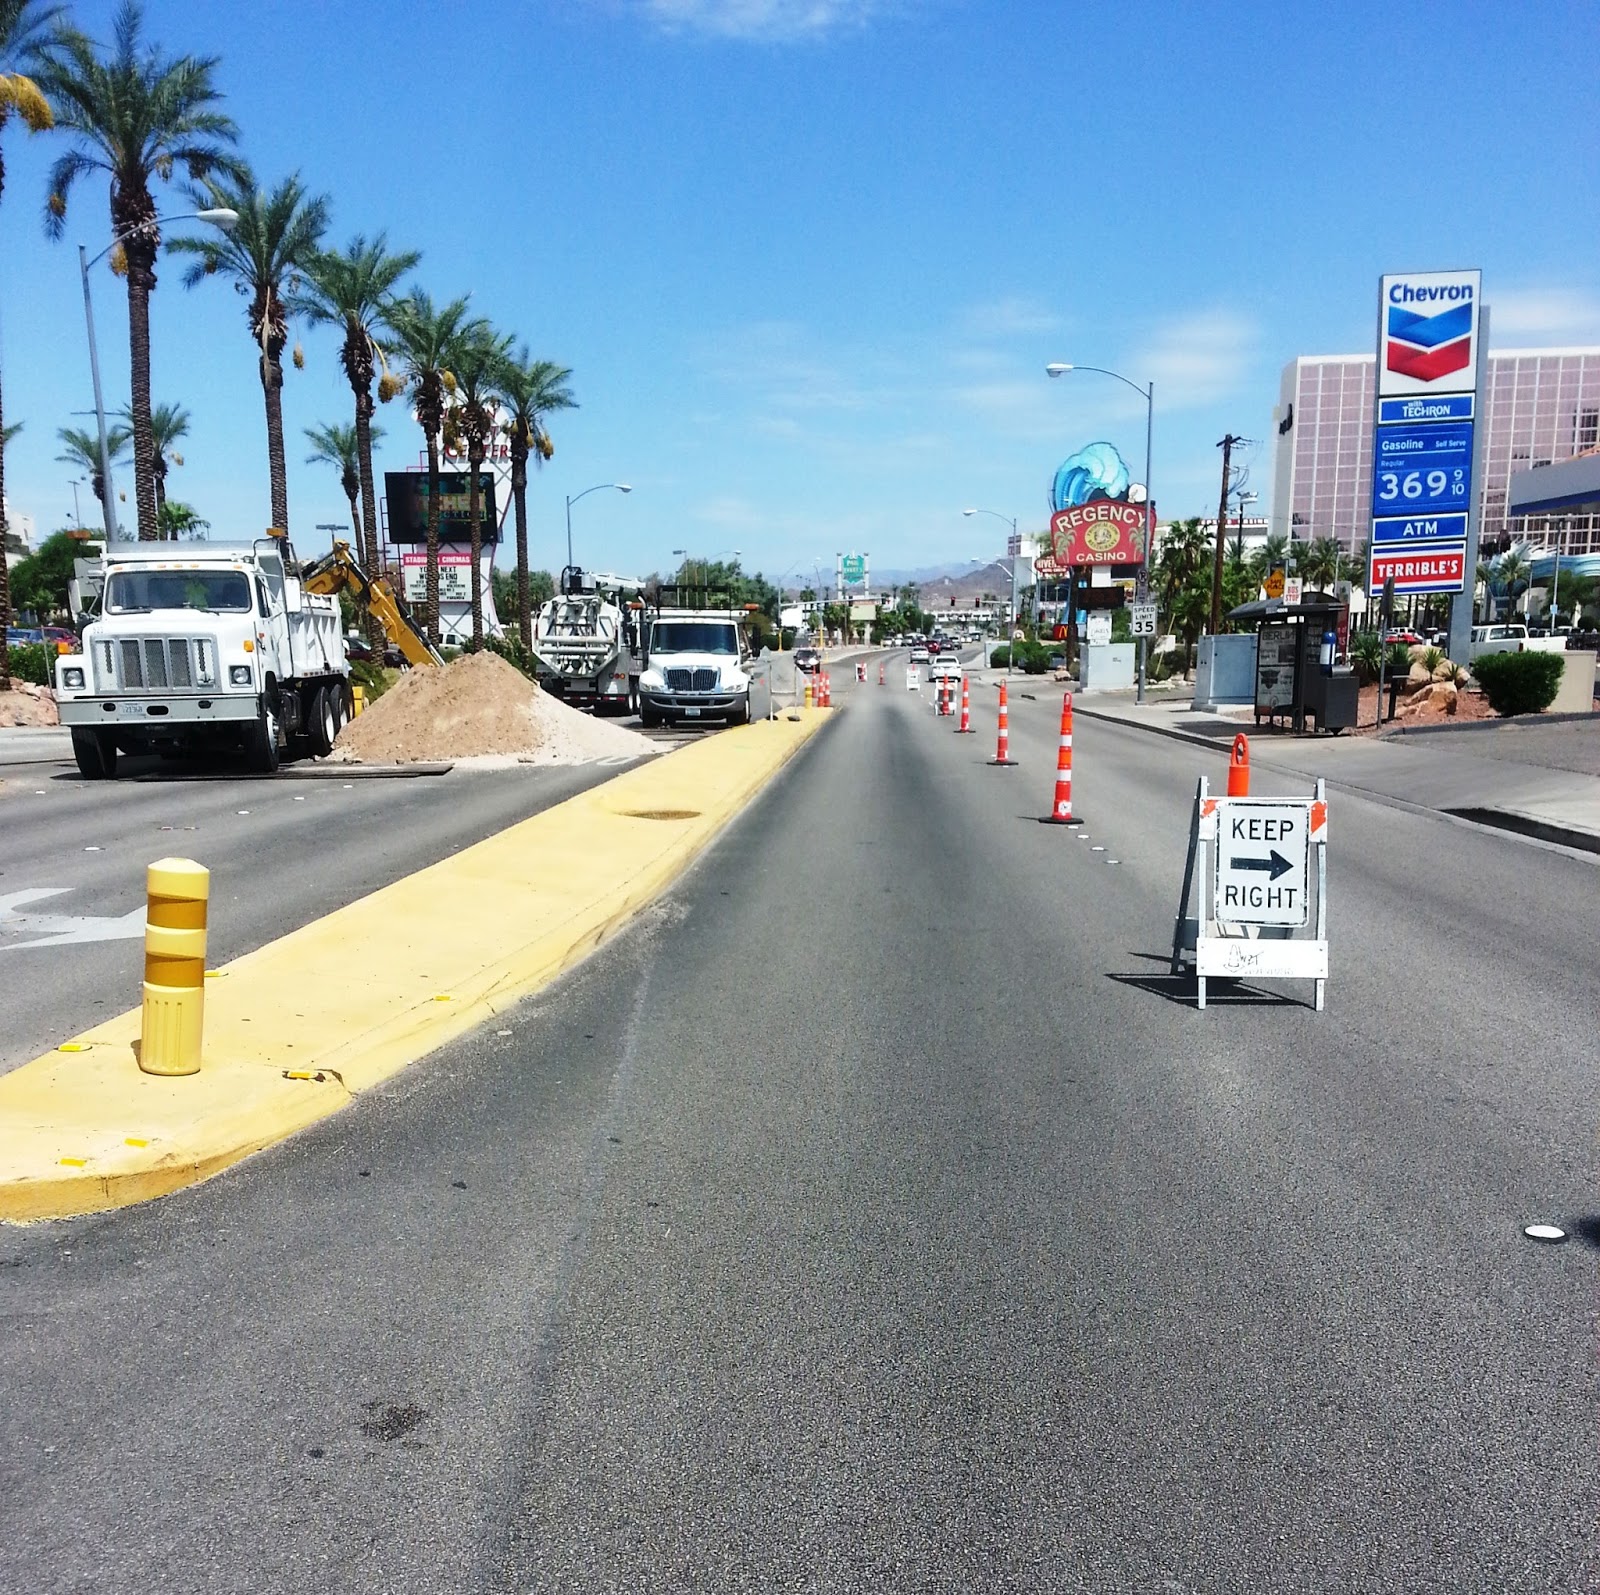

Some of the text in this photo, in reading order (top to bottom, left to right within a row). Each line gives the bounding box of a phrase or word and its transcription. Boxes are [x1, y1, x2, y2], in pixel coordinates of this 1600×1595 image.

[1389, 284, 1473, 303] Chevron
[1402, 405, 1451, 417] TECHRON
[445, 444, 509, 458] CETER
[1382, 440, 1424, 450] Gasoline
[1451, 483, 1465, 495] 10
[1056, 506, 1146, 532] REGENCY
[1403, 521, 1438, 537] ATM
[1076, 552, 1126, 562] CASINO
[1377, 559, 1459, 579] TERRIBLE'S
[1287, 586, 1299, 594] BUS
[1285, 594, 1300, 603] STOP
[1134, 621, 1154, 633] 35
[1232, 818, 1294, 842] KEEP
[1225, 885, 1298, 909] RIGHT
